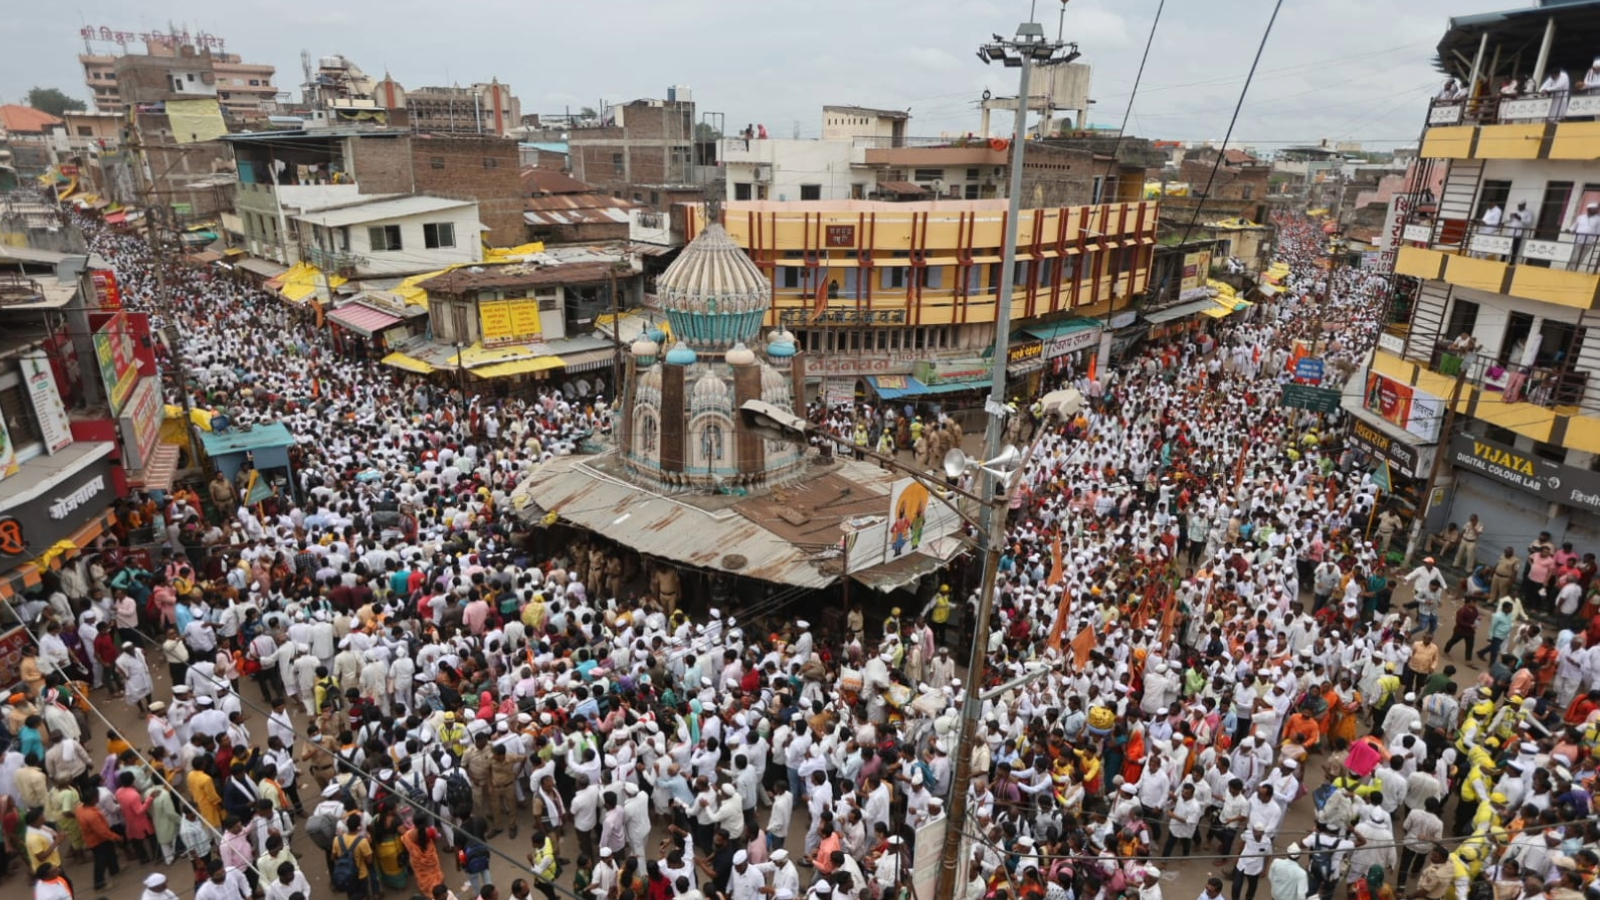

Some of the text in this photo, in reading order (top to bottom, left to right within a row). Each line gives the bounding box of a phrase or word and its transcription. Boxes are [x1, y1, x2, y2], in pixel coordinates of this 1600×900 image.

[1457, 452, 1486, 470] DIGITAL
[1488, 464, 1522, 484] COLOUR
[1523, 478, 1541, 491] LAB
[1474, 442, 1533, 476] VIJAYA
[48, 475, 105, 520] भोजनालय
